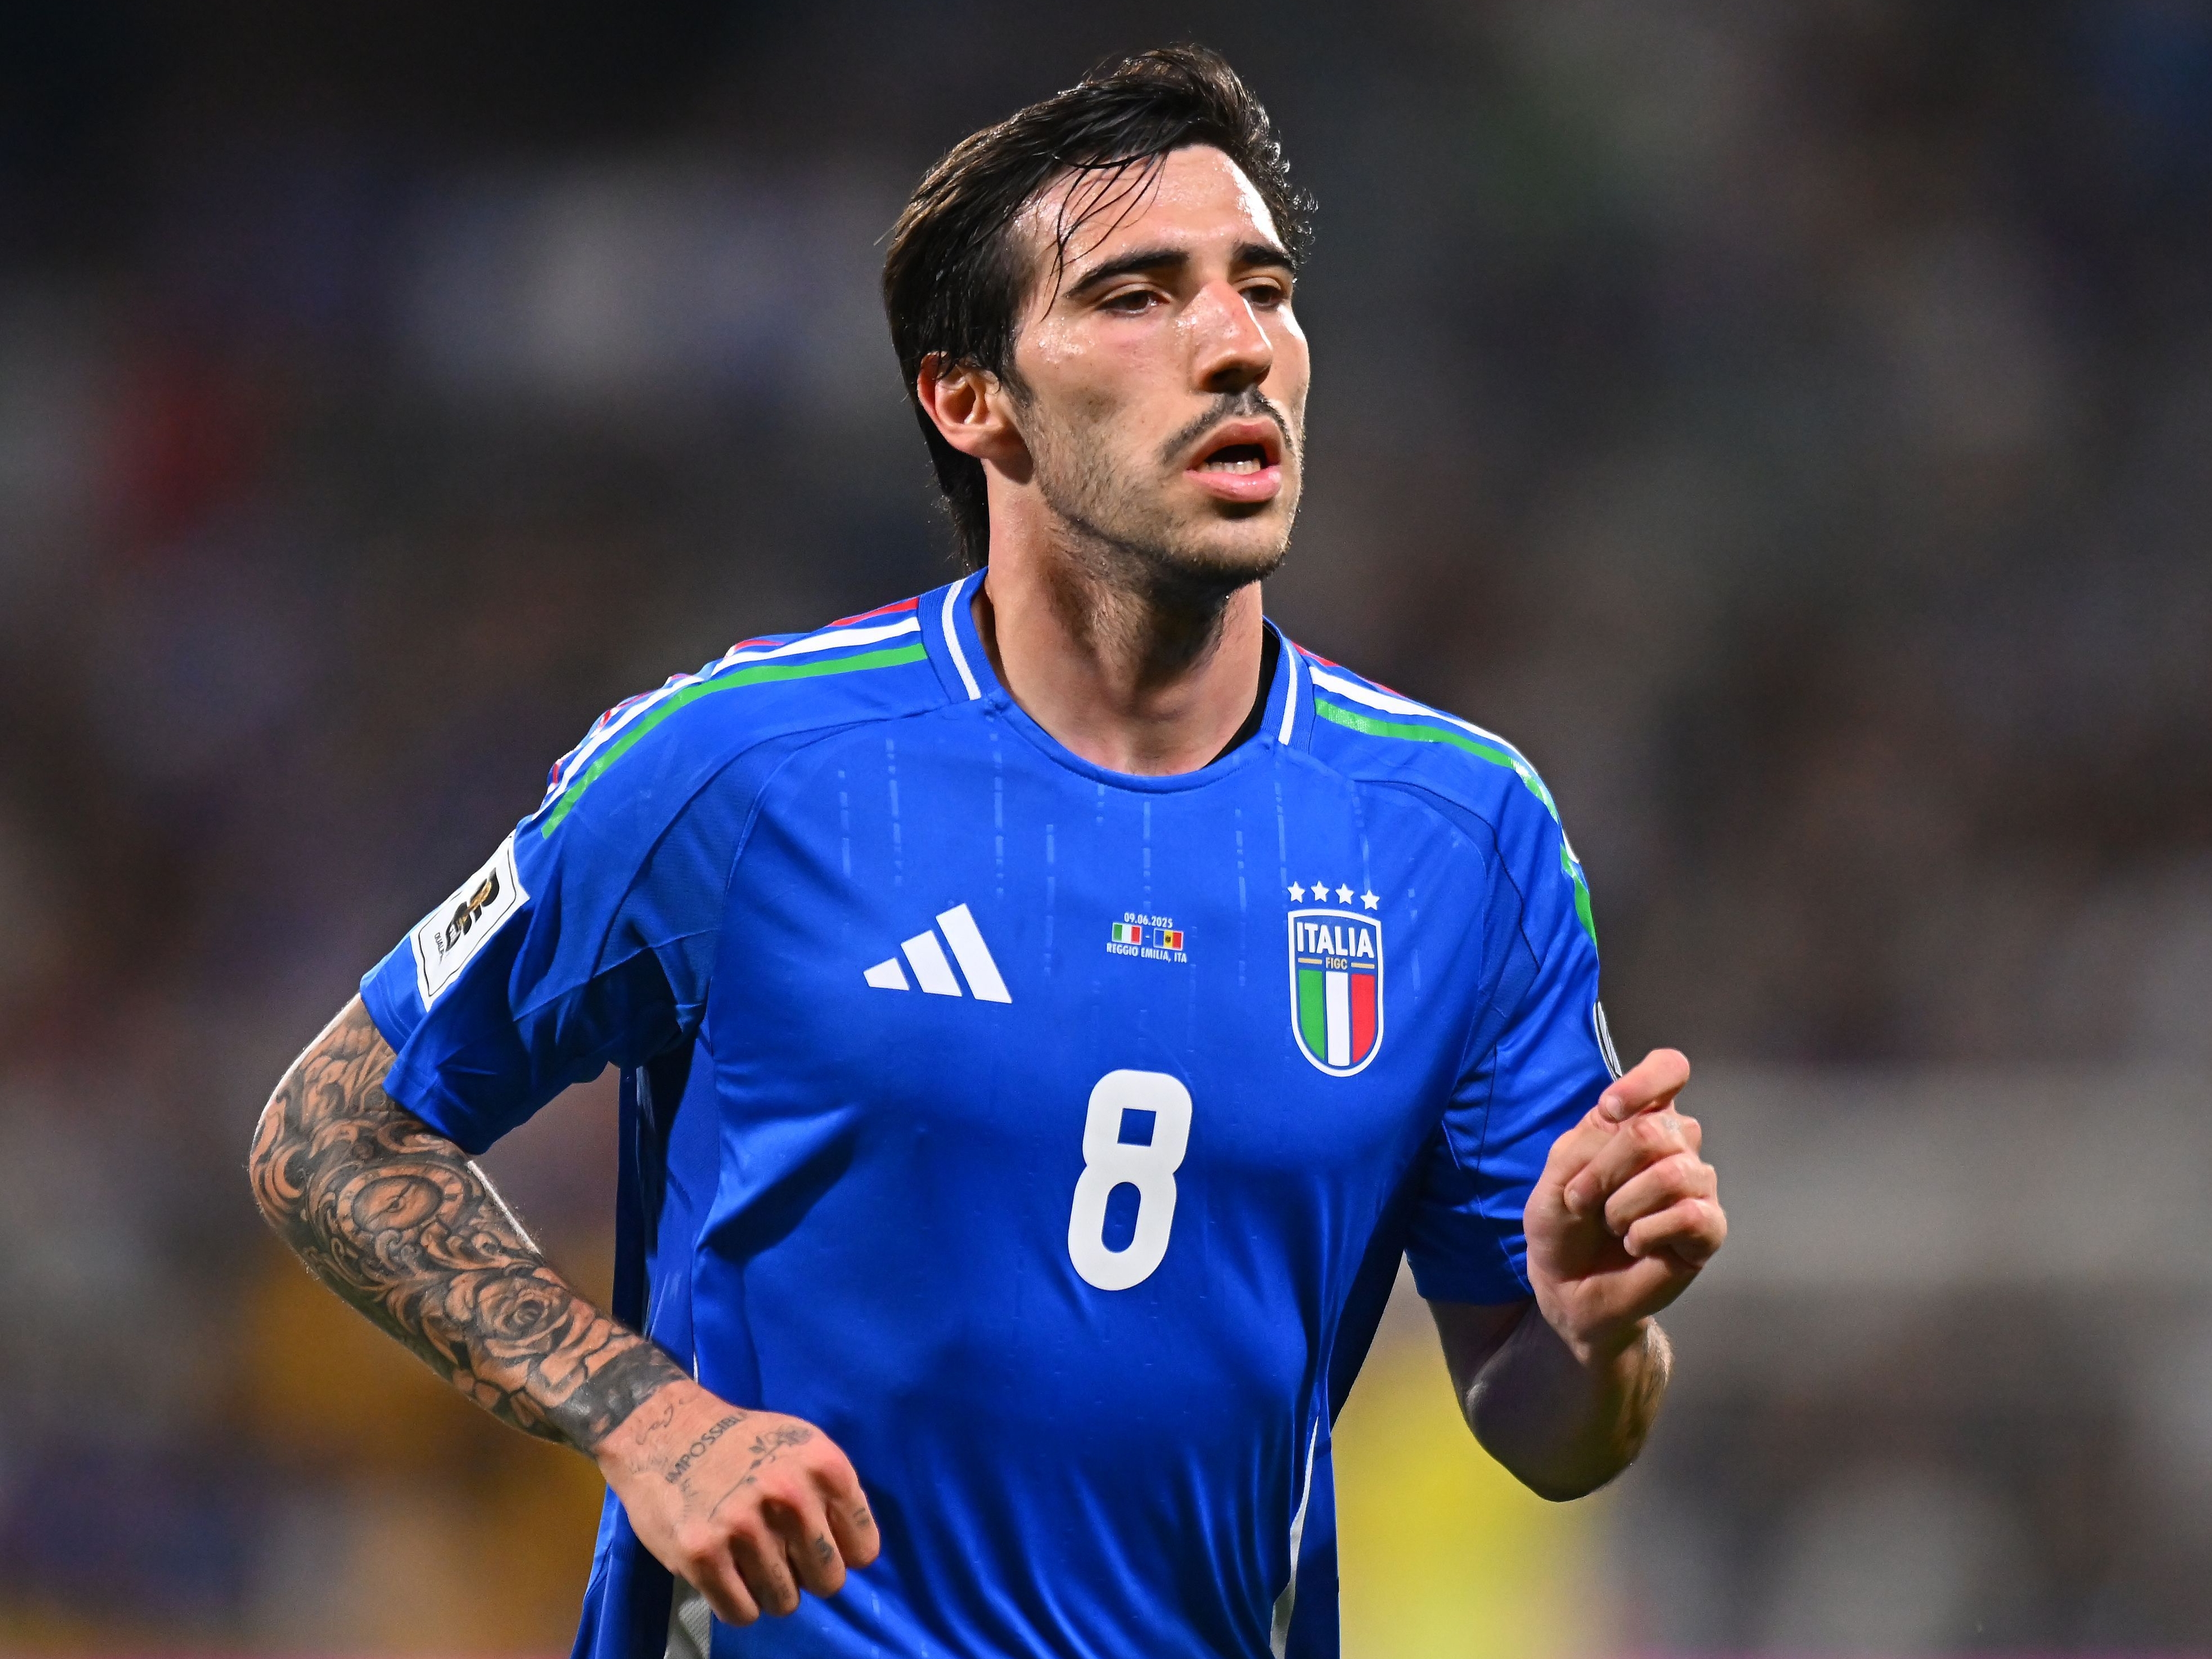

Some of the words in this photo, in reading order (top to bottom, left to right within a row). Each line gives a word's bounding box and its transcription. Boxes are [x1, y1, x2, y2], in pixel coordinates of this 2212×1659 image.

[1124, 912, 1173, 928] 09.06.2025
[1296, 921, 1375, 959] ITALIA
[1107, 943, 1138, 957] REGGIO
[1141, 948, 1171, 962] EMILIA,
[1174, 952, 1187, 963] ITA
[1326, 957, 1348, 970] FIGC
[1068, 1068, 1193, 1291] 8
